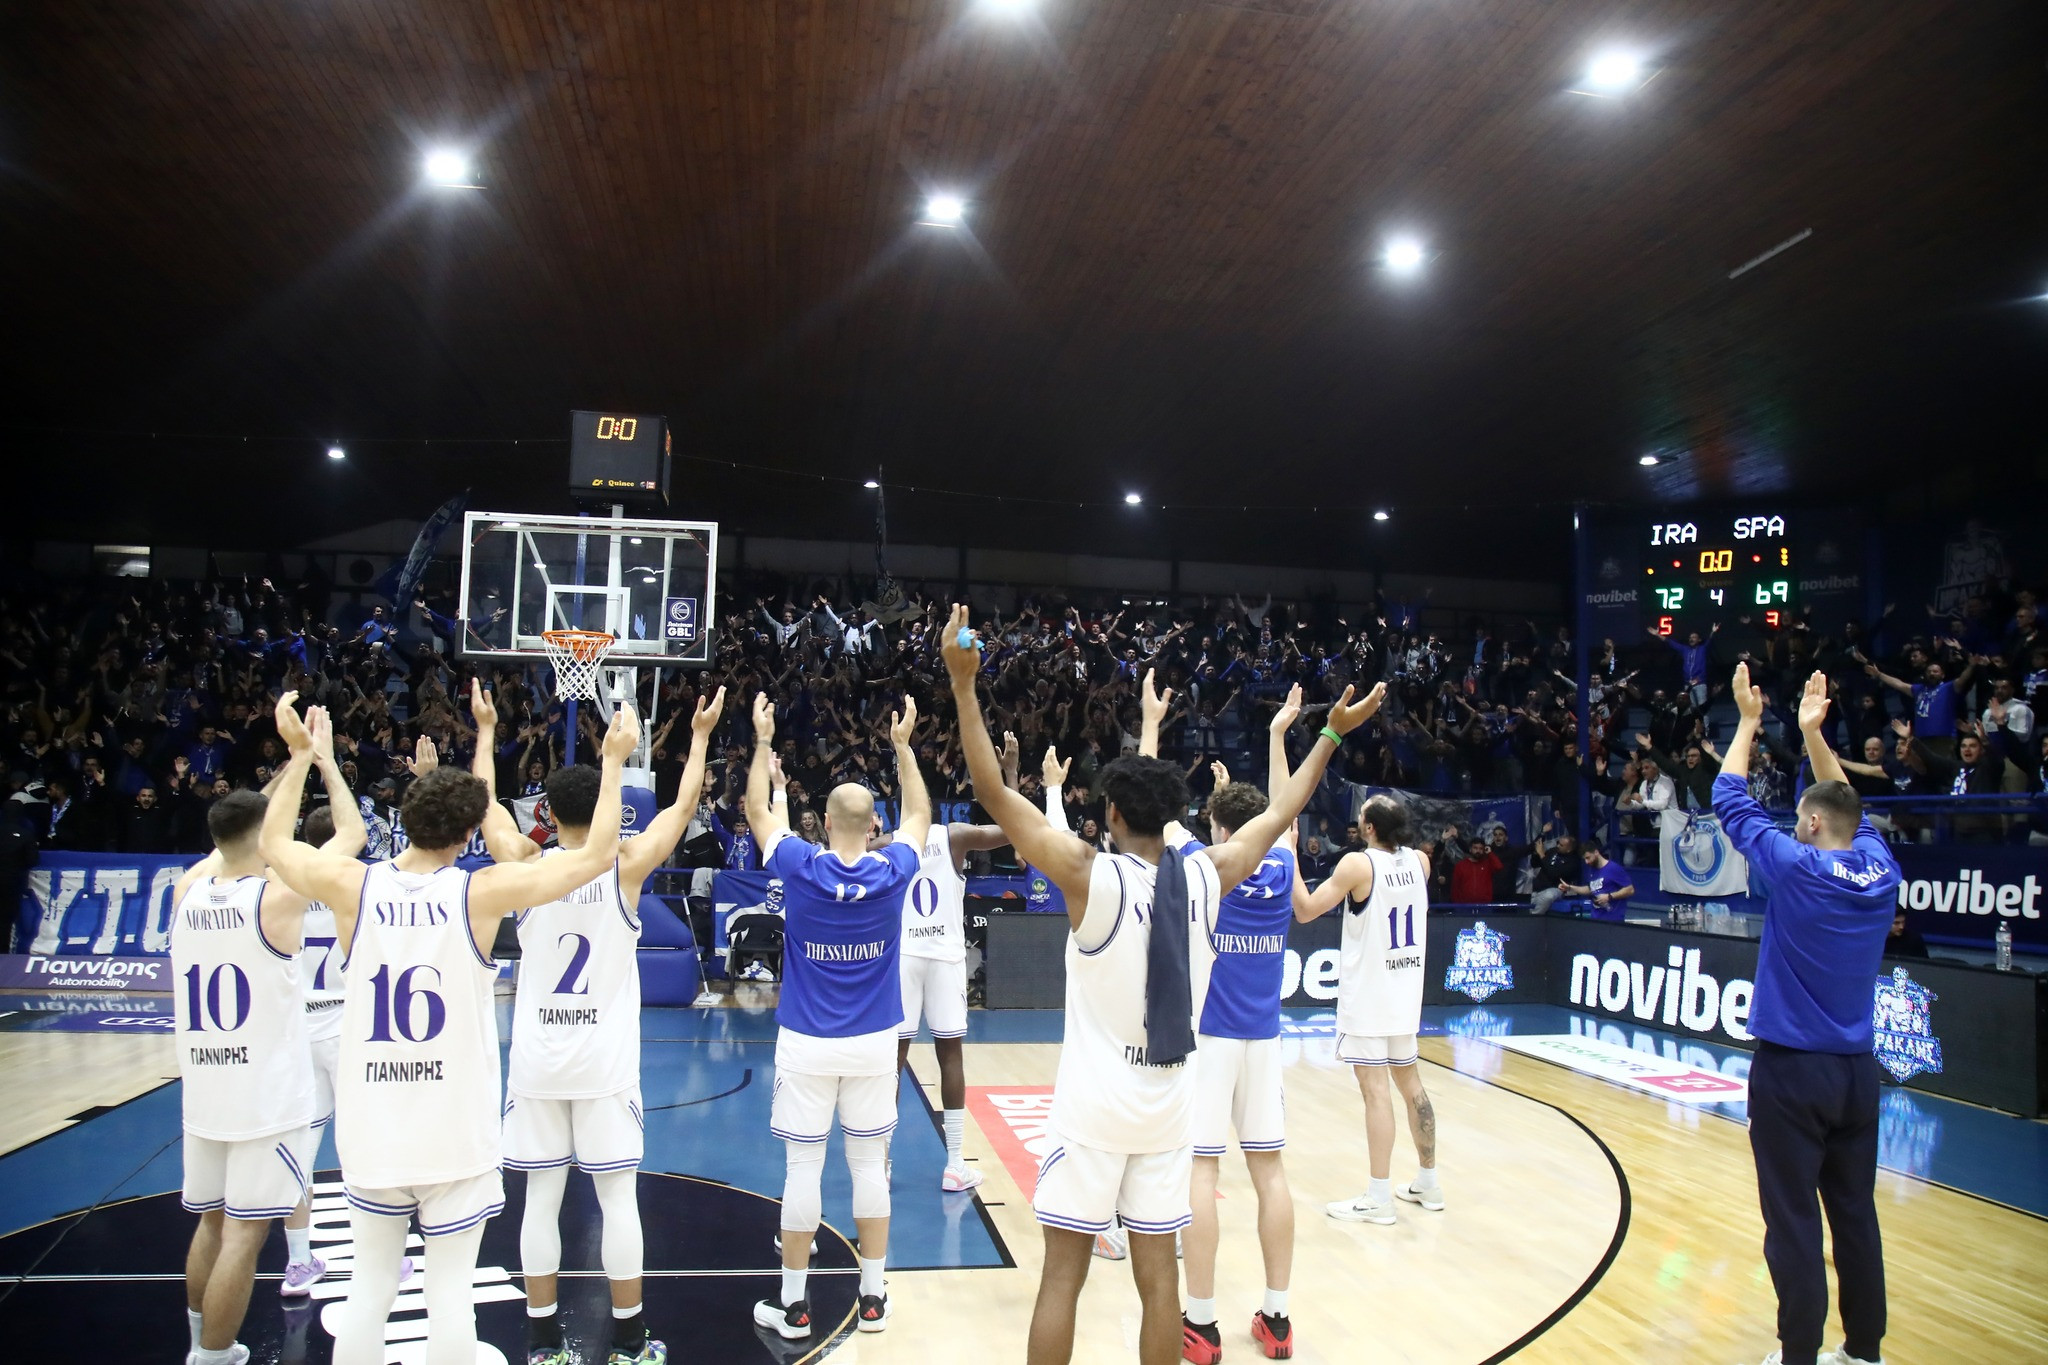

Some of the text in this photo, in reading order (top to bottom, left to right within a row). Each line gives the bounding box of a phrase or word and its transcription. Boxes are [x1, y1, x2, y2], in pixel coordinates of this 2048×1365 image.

[1651, 515, 1785, 546] IRA SPA
[1656, 581, 1788, 609] 72 4 69
[1800, 575, 1859, 592] novibet
[668, 628, 692, 637] GBL
[1660, 617, 1672, 635] 5
[912, 877, 939, 918] 0
[1898, 869, 2042, 919] novibet
[185, 907, 245, 931] MORAITIS
[374, 901, 448, 927] SYLLAS
[908, 925, 945, 939] ΓΙΑΝΝΙΡΗΣ
[1388, 904, 1418, 950] 11
[804, 940, 885, 962] THESSALONIKI
[1212, 932, 1284, 954] THESSALONIKI
[25, 957, 161, 979] Γιαννίρης
[303, 937, 338, 990] 7
[551, 932, 591, 995] 2
[48, 977, 129, 988] Automobility
[1569, 945, 1758, 1041] novibe
[183, 963, 251, 1032] 10
[364, 964, 446, 1043] 16
[191, 1047, 249, 1065] ΓΙΑΝΝΙΡΗΣ
[366, 1060, 443, 1083] ΓΙΑΝΝΙΡΗΣ
